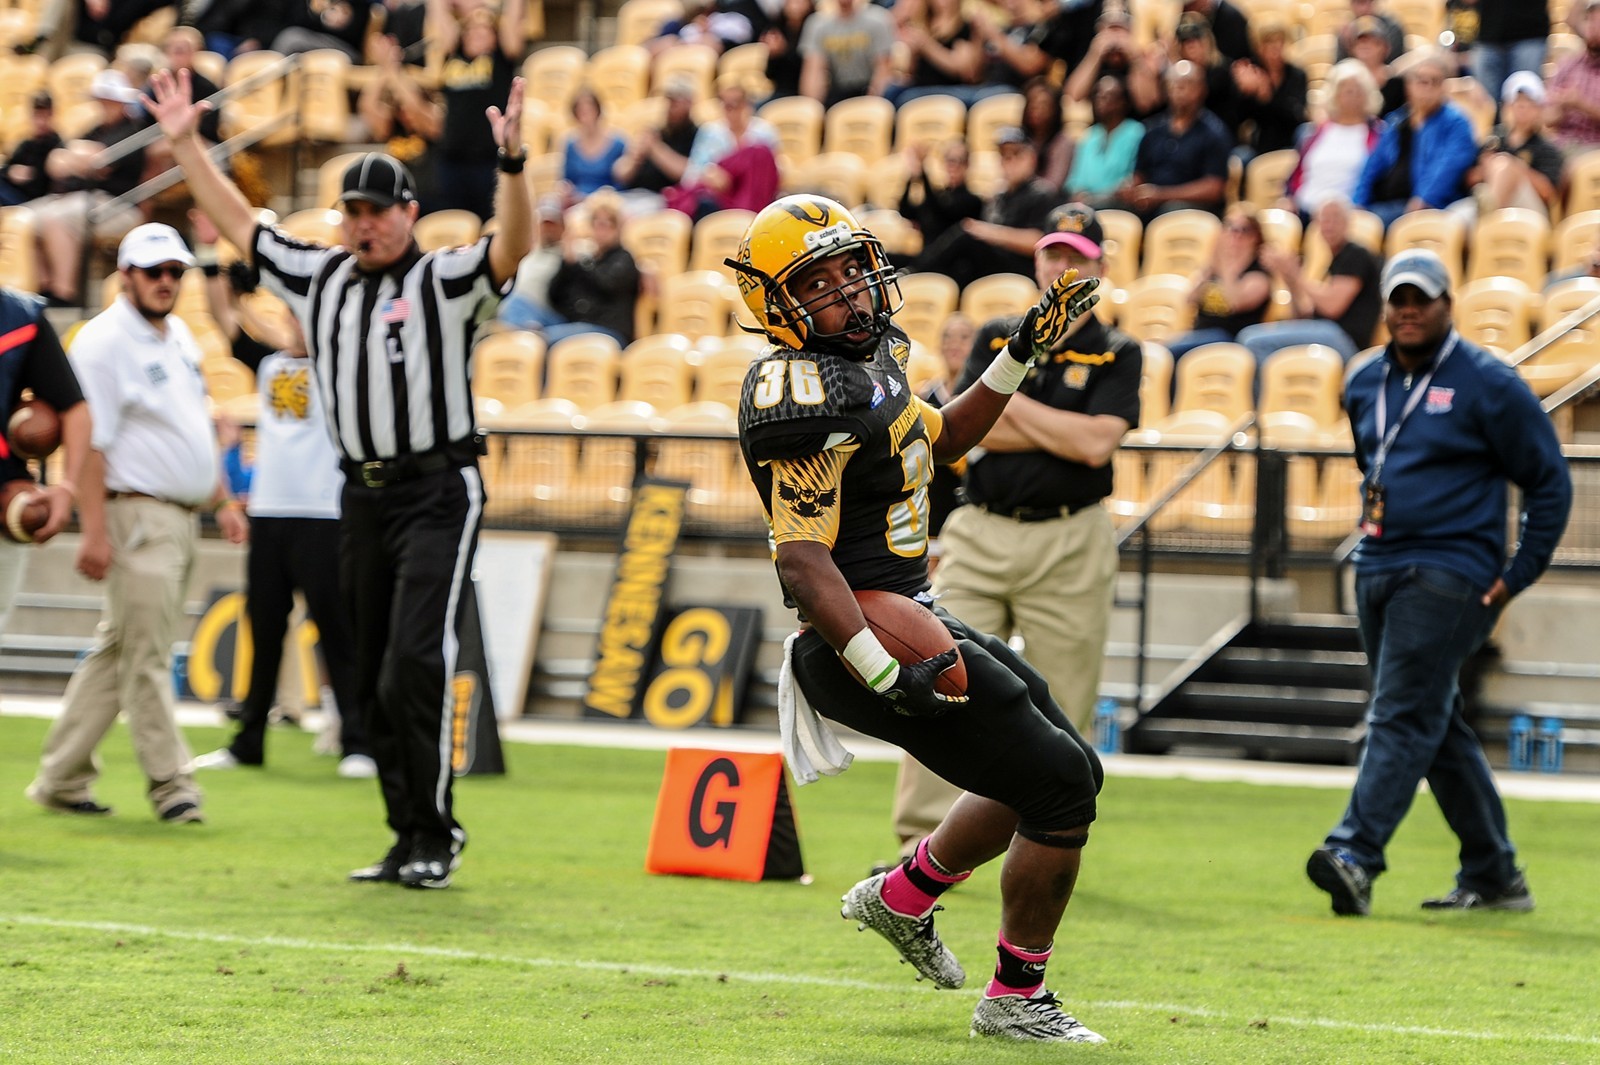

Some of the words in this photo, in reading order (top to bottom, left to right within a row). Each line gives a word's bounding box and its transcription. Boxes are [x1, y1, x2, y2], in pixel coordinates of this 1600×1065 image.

[753, 359, 826, 410] 36
[885, 437, 934, 558] 3
[584, 484, 687, 719] KENNESAW
[642, 606, 732, 731] GO
[688, 757, 741, 850] G
